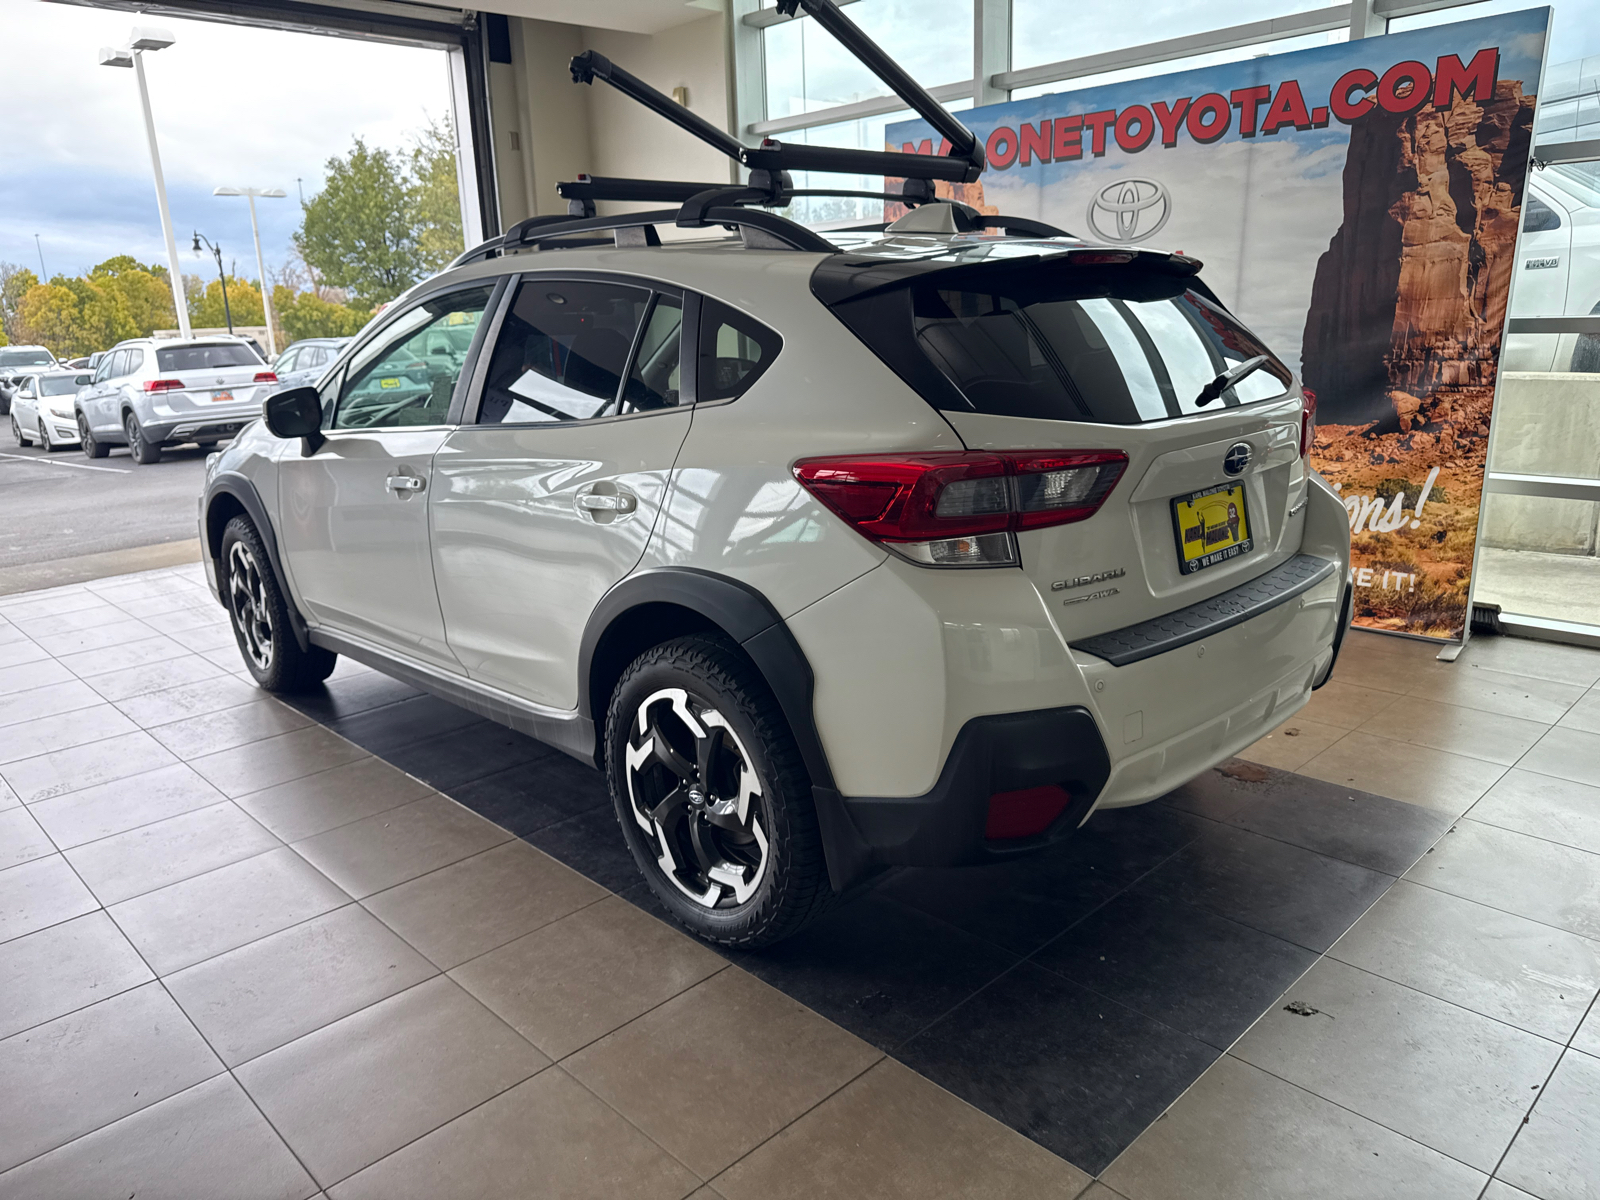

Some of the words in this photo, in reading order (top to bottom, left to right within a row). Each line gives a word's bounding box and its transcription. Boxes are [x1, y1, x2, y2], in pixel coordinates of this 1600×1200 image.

[1229, 508, 1236, 518] 32
[1210, 551, 1223, 563] MAKE
[1051, 567, 1126, 591] SUBARU
[1382, 570, 1416, 592] IT!
